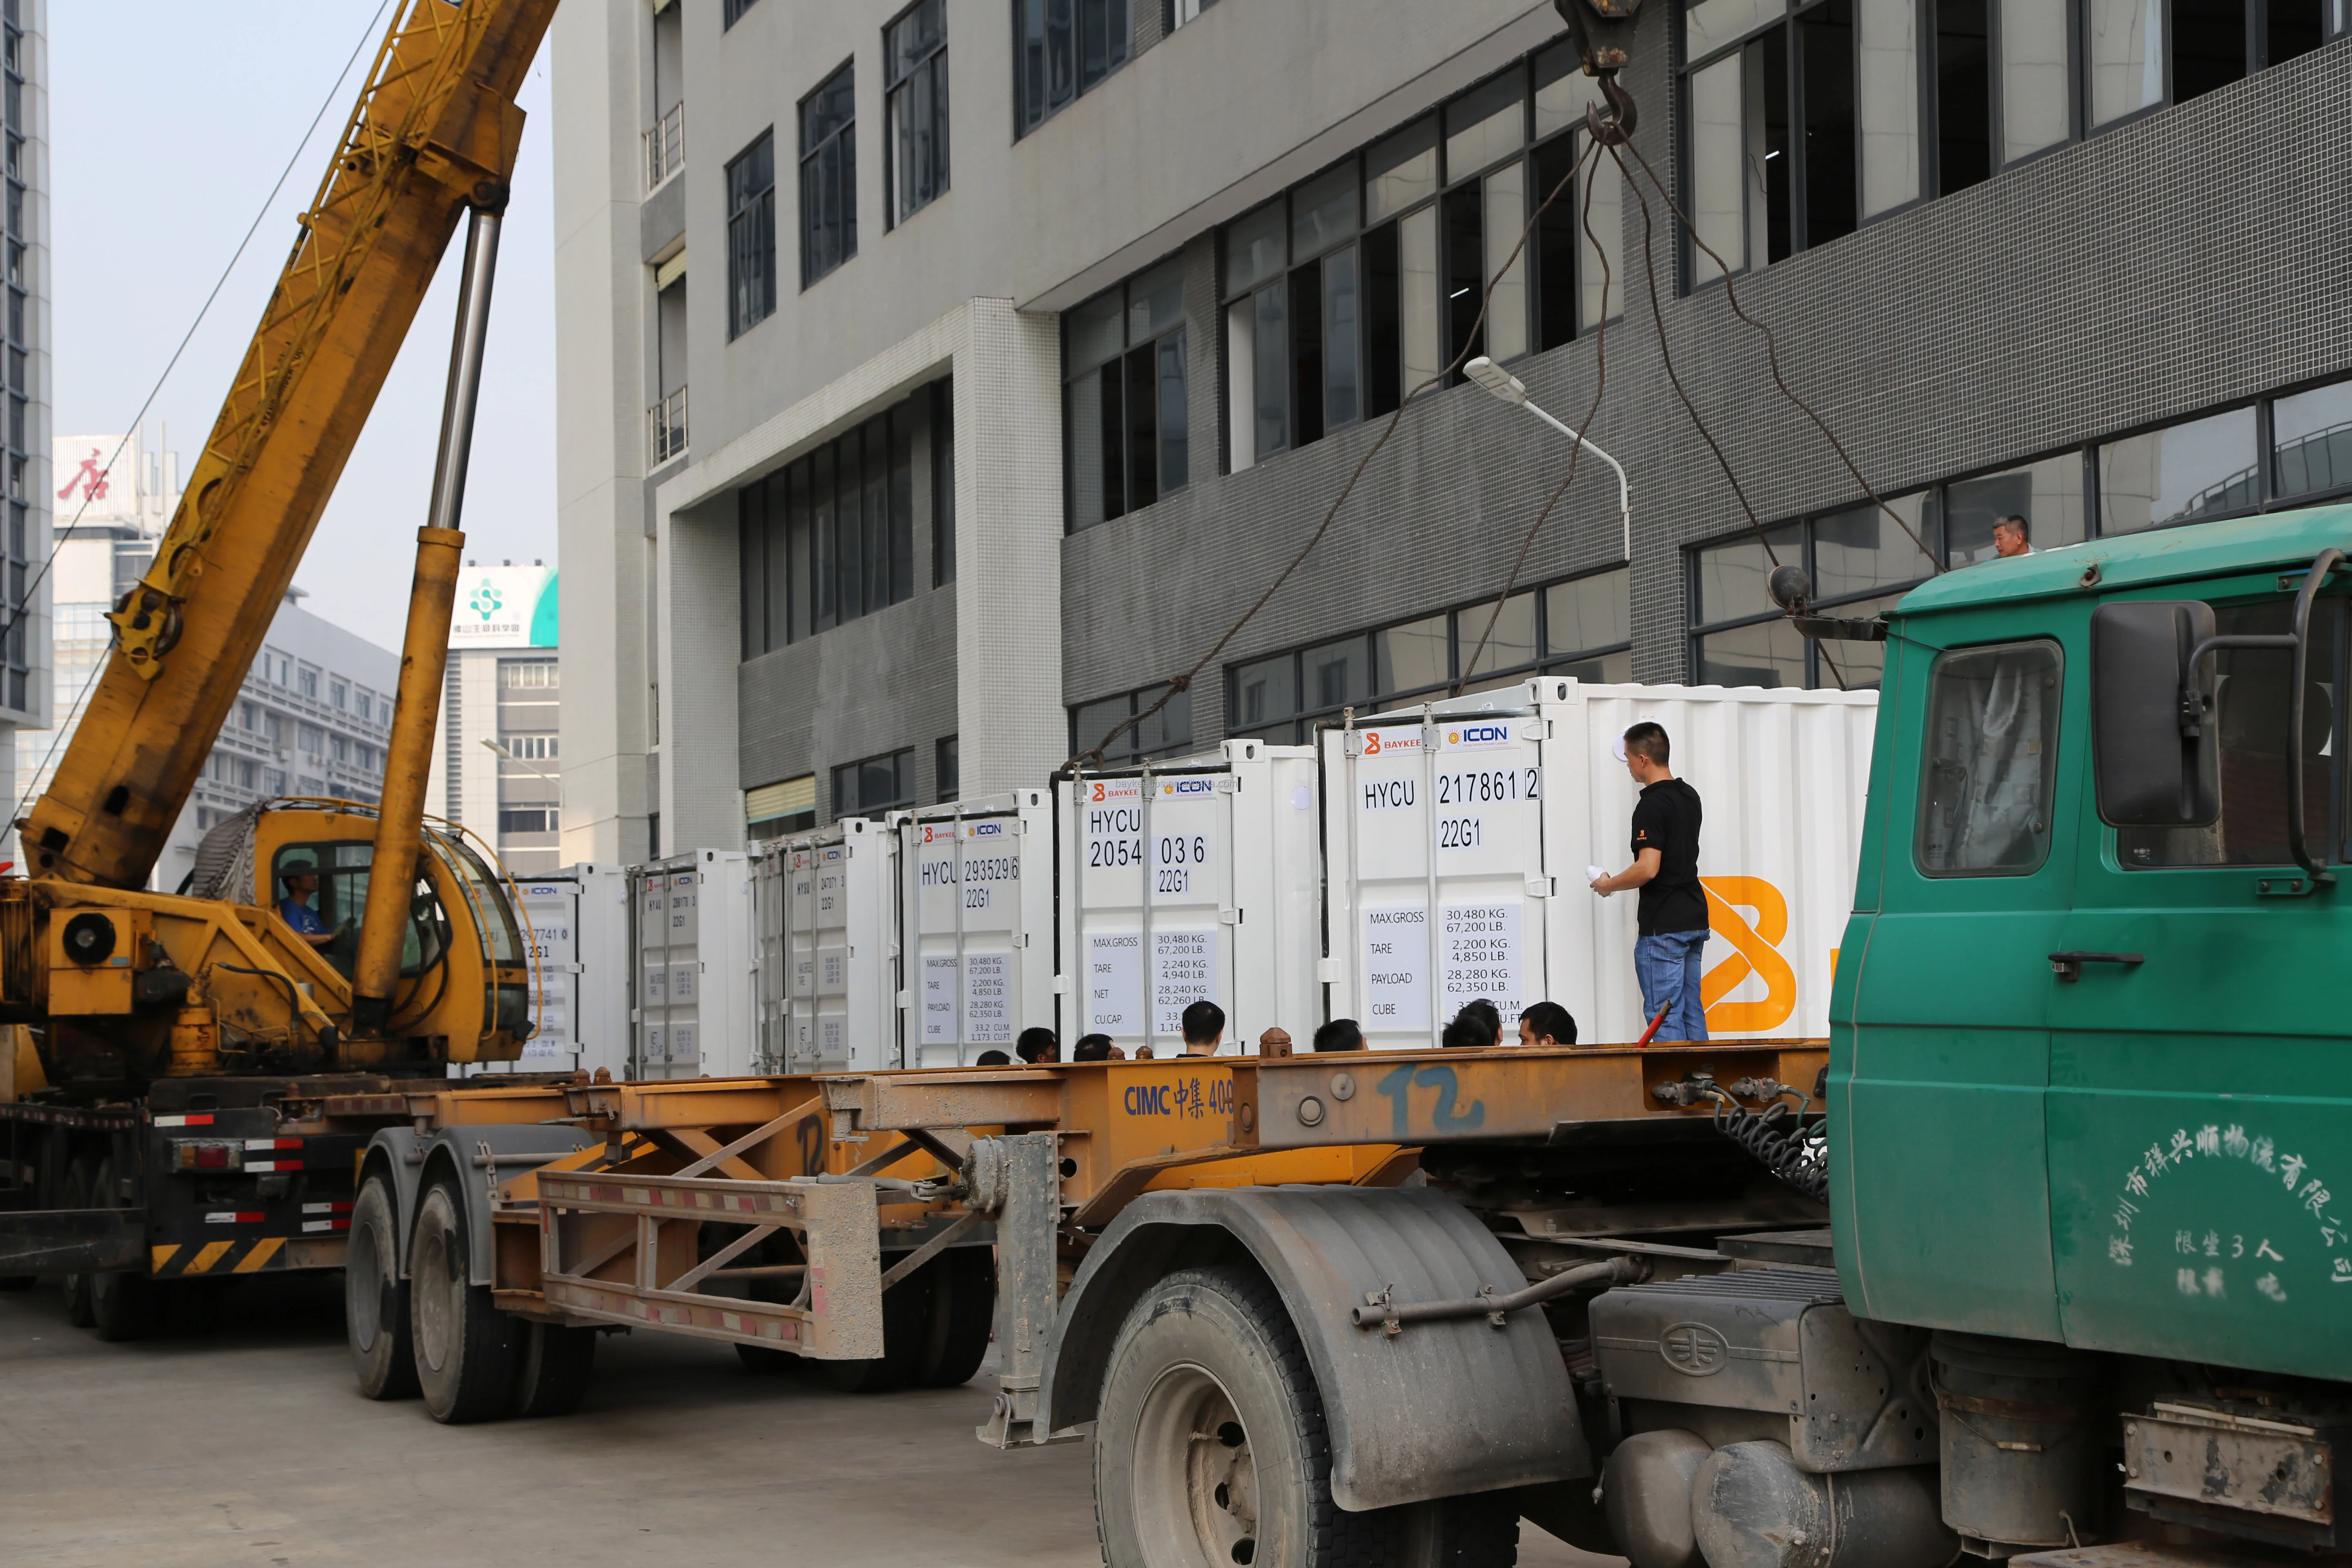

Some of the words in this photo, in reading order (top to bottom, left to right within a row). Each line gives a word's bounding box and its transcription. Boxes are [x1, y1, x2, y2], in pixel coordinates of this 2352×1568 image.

[1463, 726, 1507, 742] ICON
[1384, 739, 1422, 749] BAYKEE
[1108, 788, 1138, 797] BAYKEE
[1176, 780, 1212, 793] ICON
[1365, 780, 1414, 809] HYCU
[1439, 770, 1515, 804] 217861
[1527, 769, 1538, 798] 2
[1091, 809, 1140, 833] HYCU
[977, 824, 1001, 835] ICON
[1441, 818, 1480, 848] 22G1
[827, 850, 841, 860] ICON
[1091, 839, 1142, 867] 2054
[922, 861, 956, 885] HYCU
[965, 858, 1008, 882] 293529
[1011, 858, 1018, 878] 6
[679, 876, 692, 885] ICON
[1159, 869, 1188, 892] 22G1
[822, 896, 834, 910] 22G1
[966, 888, 989, 908] 22G1
[673, 915, 685, 927] 22G1
[1370, 911, 1424, 924] MAX.GROSS
[1446, 909, 1485, 921] 30,480
[1489, 909, 1508, 918] KG.
[1447, 922, 1486, 933] 67,200
[1489, 922, 1506, 931] LB.
[1094, 937, 1138, 948] MAX.GROSS
[1158, 935, 1189, 944] 30,480
[1192, 935, 1207, 943] KG.
[1370, 943, 1392, 954] TARE
[1452, 939, 1486, 951] 2,200
[1490, 939, 1510, 948] KG.
[1158, 946, 1189, 955] 67,200
[927, 959, 957, 968] MAX.GROSS
[969, 958, 991, 966] 30,480
[1452, 952, 1486, 963] 4,850
[1490, 951, 1508, 961] LB.
[969, 967, 991, 975] 67,200
[1094, 964, 1112, 973] TARE
[1163, 960, 1190, 970] 2,240
[1193, 960, 1209, 968] KG.
[1162, 971, 1190, 980] 4,940
[1372, 973, 1412, 984] PAYLOAD
[1447, 969, 1488, 980] 28,280
[1492, 969, 1511, 978] KG.
[927, 981, 940, 989] TARE
[1448, 982, 1488, 993] 62,350
[1492, 982, 1508, 991] LB.
[1094, 989, 1109, 998] NET
[1158, 986, 1191, 995] 28,240
[1194, 985, 1209, 993] KG.
[1158, 996, 1191, 1005] 62,260
[927, 1003, 950, 1011] PAYLOAD
[1372, 1004, 1396, 1015] CUBE
[1095, 1015, 1123, 1024] CU.CAP.
[1165, 1012, 1183, 1021] 33.
[927, 1025, 941, 1033] CUBE
[1160, 1023, 1181, 1032] 1,16
[1124, 1085, 1170, 1115] CIMC
[1174, 1077, 1204, 1120] 中集
